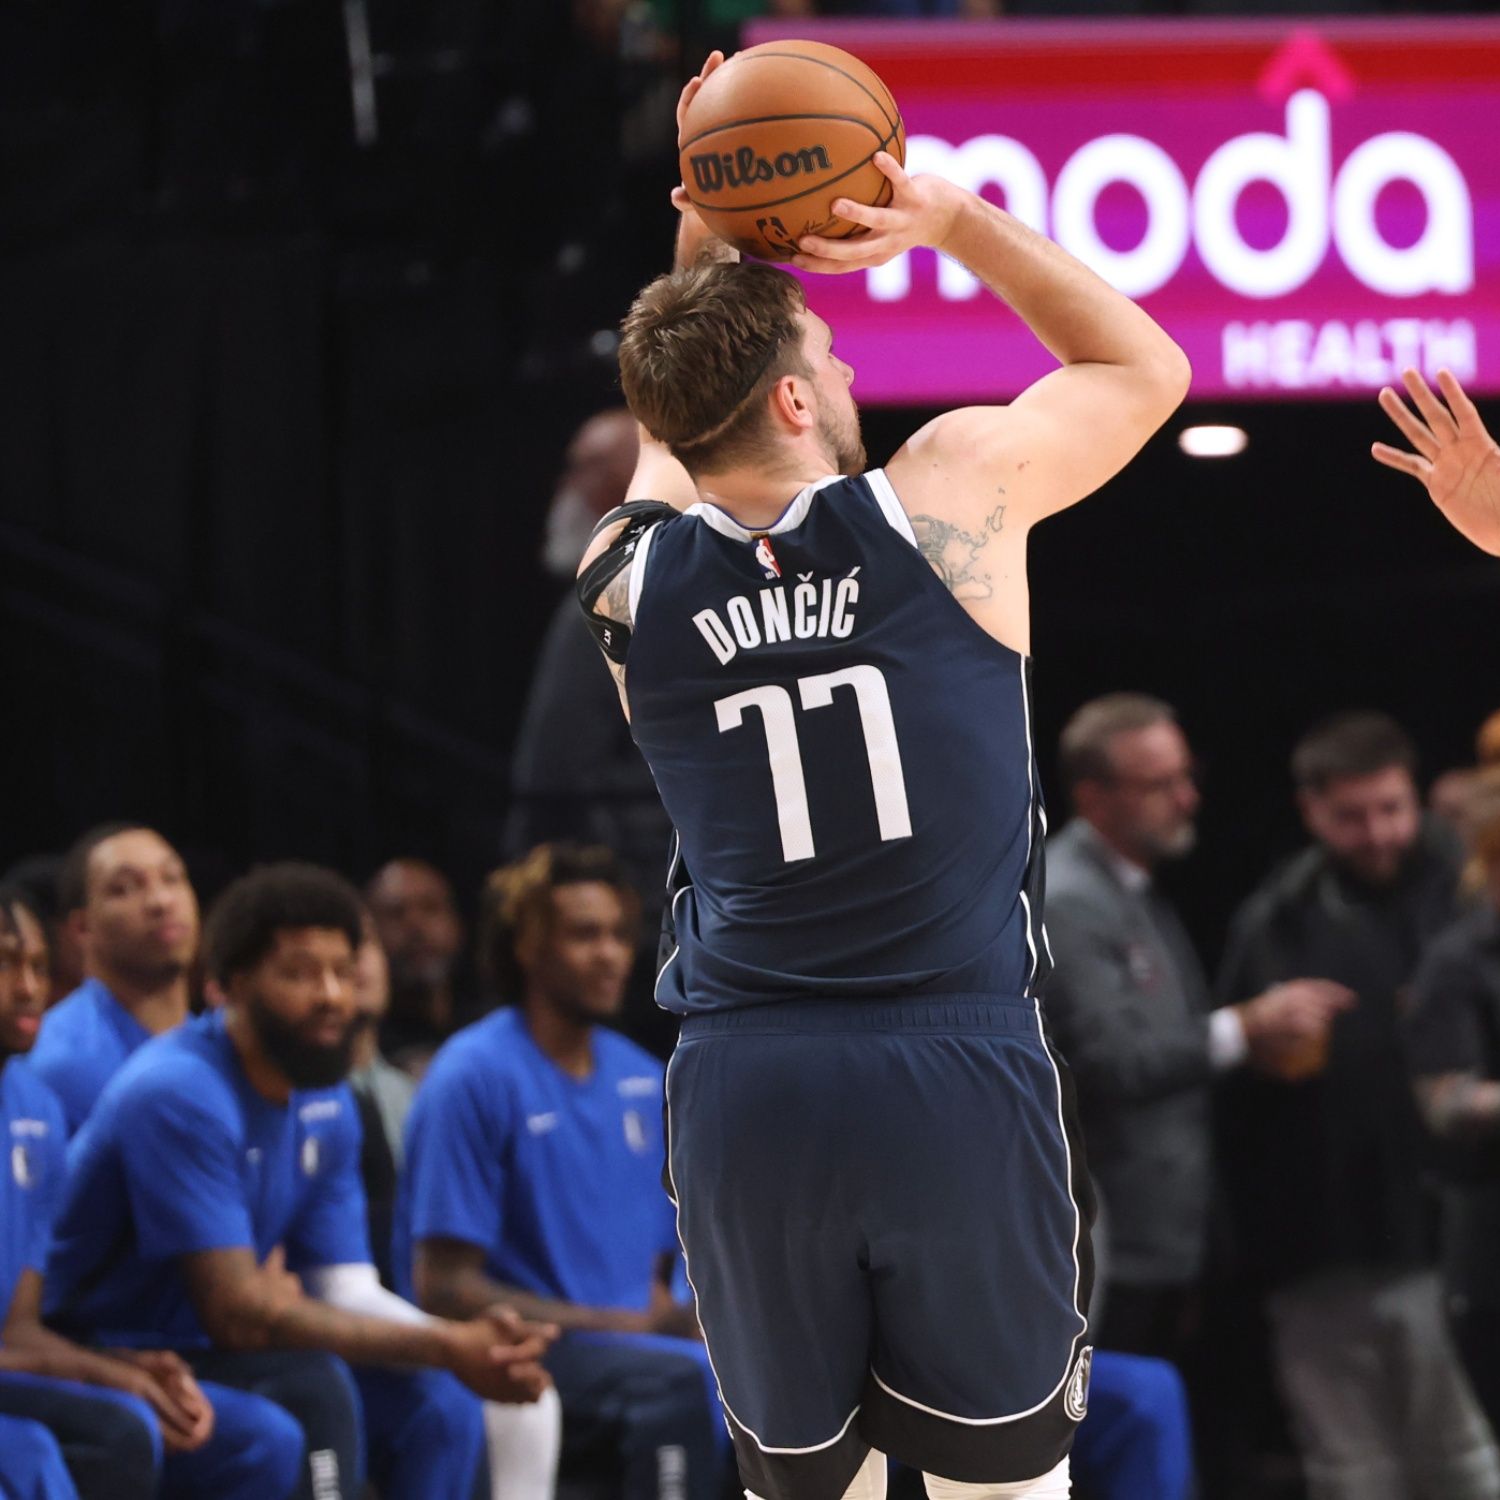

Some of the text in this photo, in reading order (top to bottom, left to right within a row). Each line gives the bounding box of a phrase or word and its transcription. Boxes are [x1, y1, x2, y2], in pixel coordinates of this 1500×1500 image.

[691, 145, 832, 192] Wilson
[1222, 318, 1477, 388] HEALTH
[692, 566, 861, 665] DONČIĆ
[714, 665, 912, 862] 77
